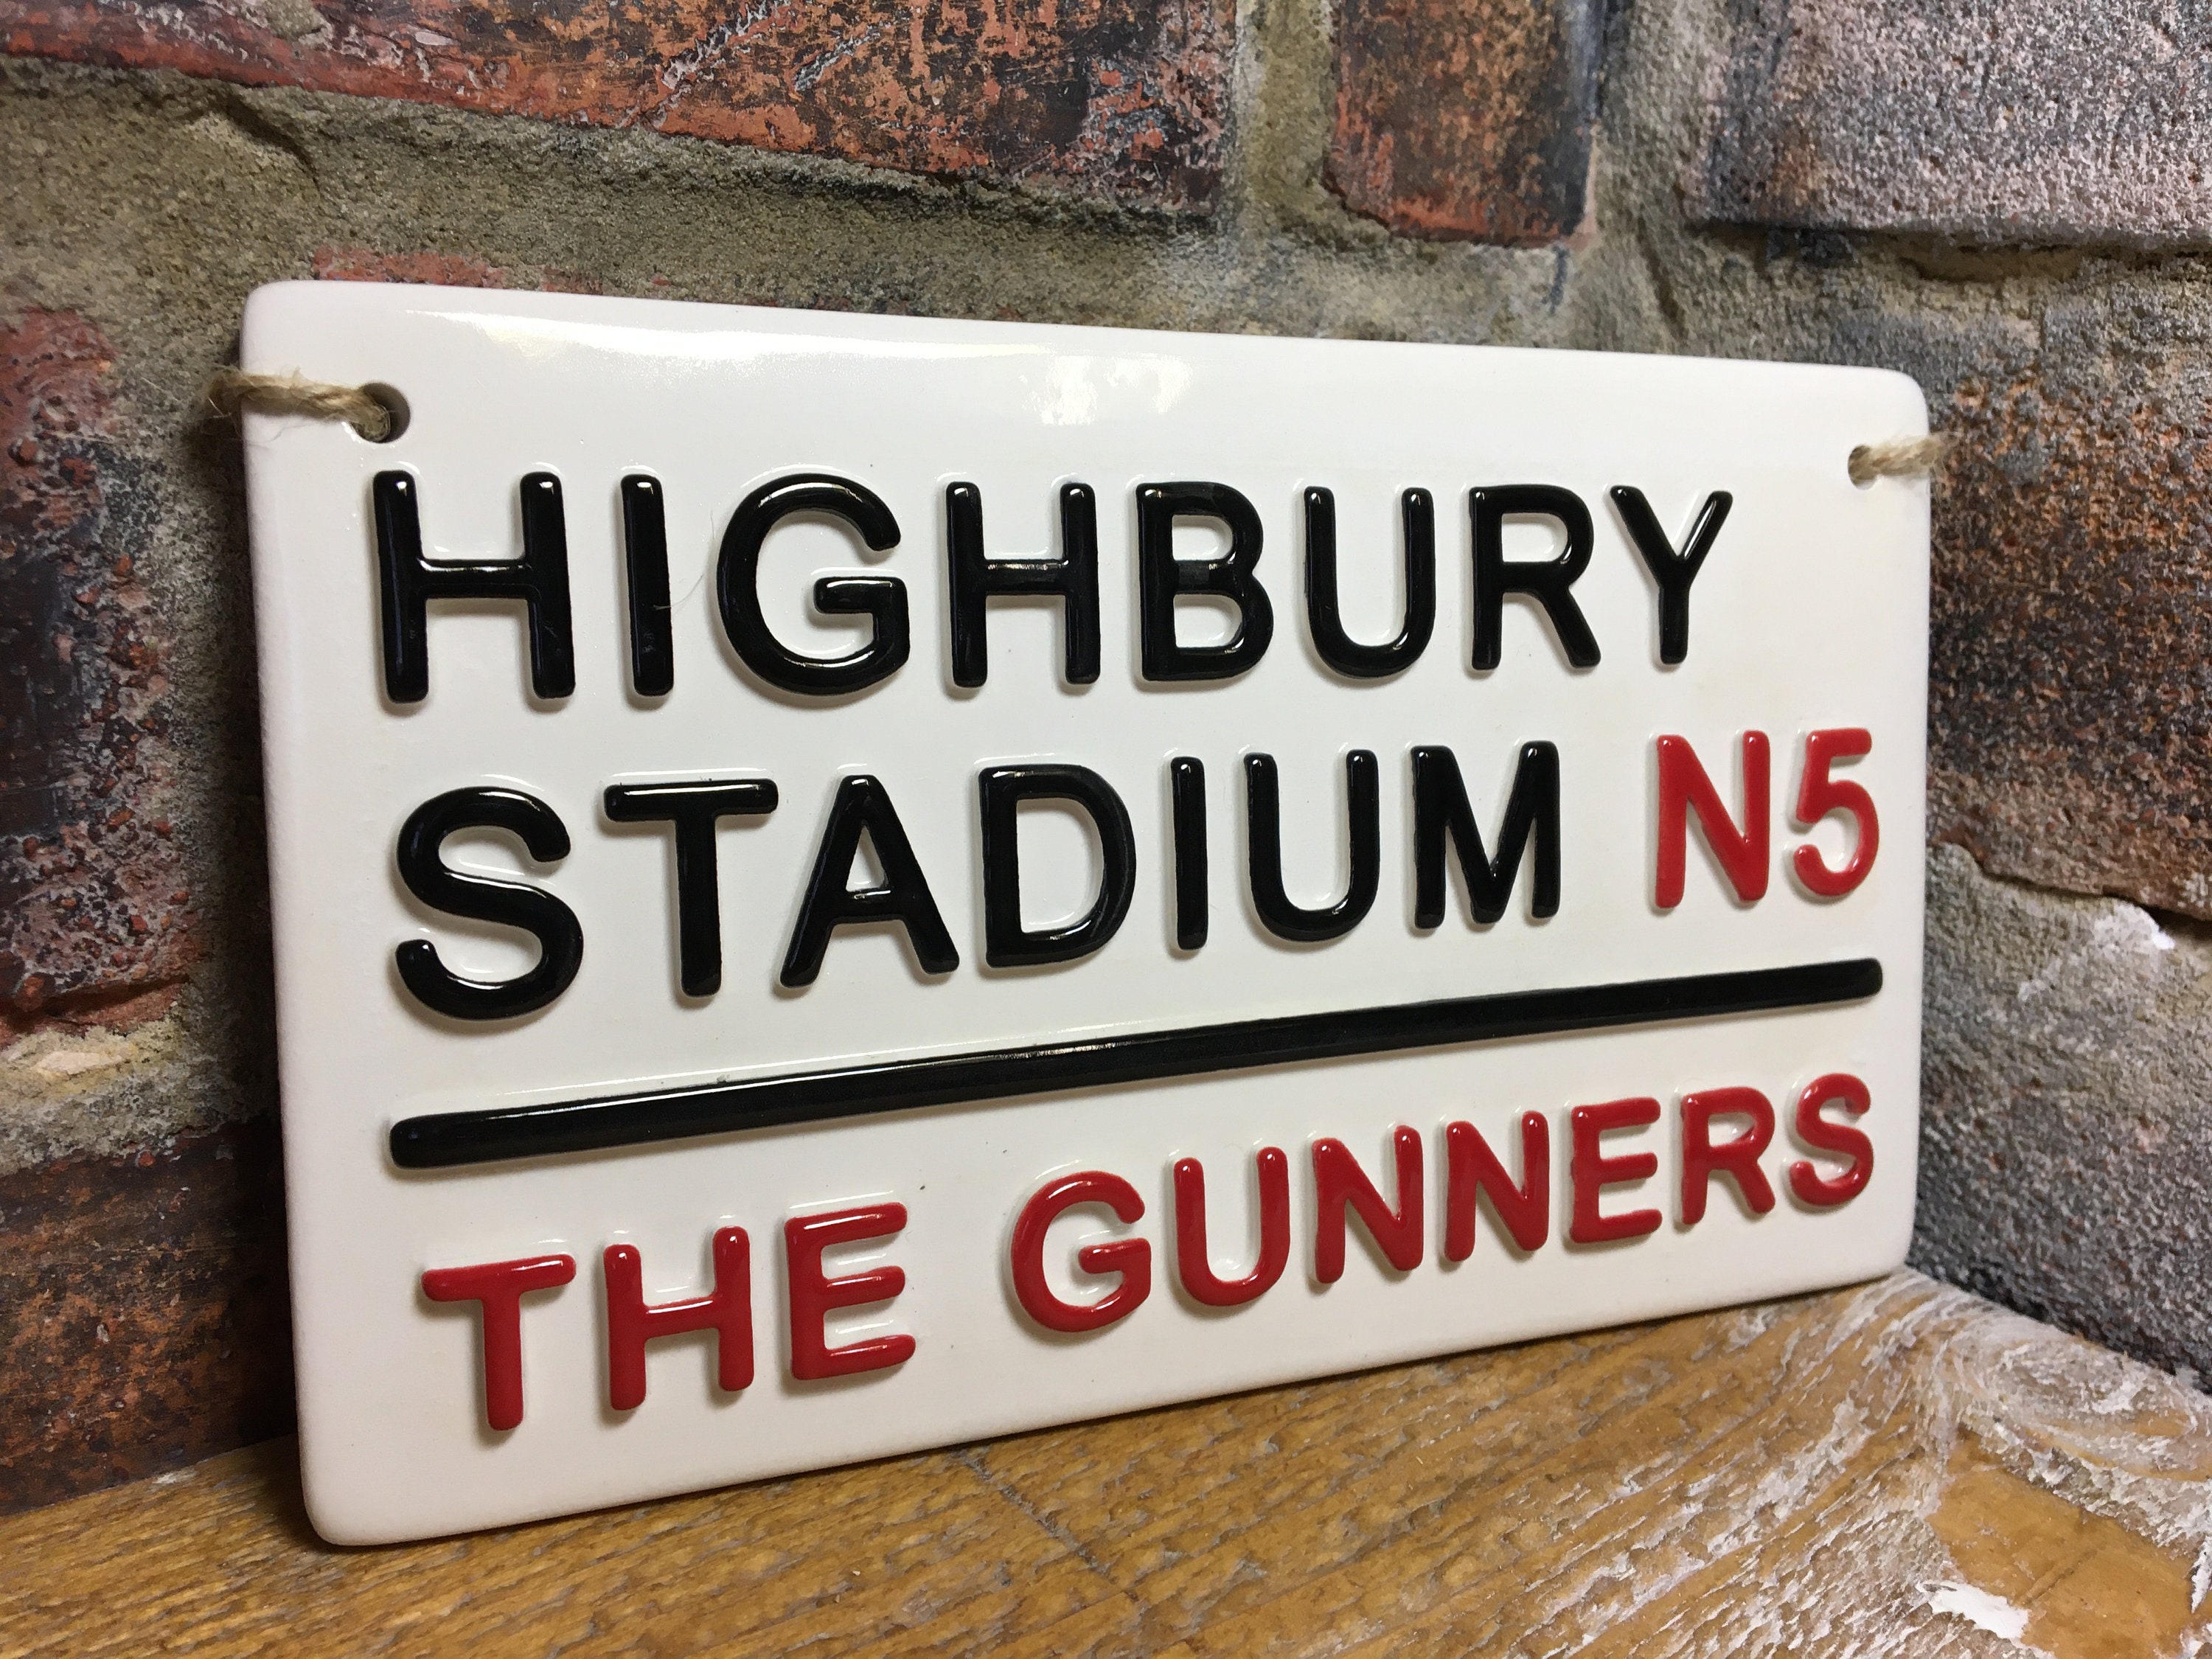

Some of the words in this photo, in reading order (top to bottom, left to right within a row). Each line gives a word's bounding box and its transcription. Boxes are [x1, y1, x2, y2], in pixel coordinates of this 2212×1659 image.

[373, 471, 1732, 703] HIGHBURY
[396, 742, 1560, 1020] STADIUM
[1656, 729, 1879, 908] N5
[422, 1203, 915, 1431] THE
[1011, 1074, 1873, 1333] GUNNERS
